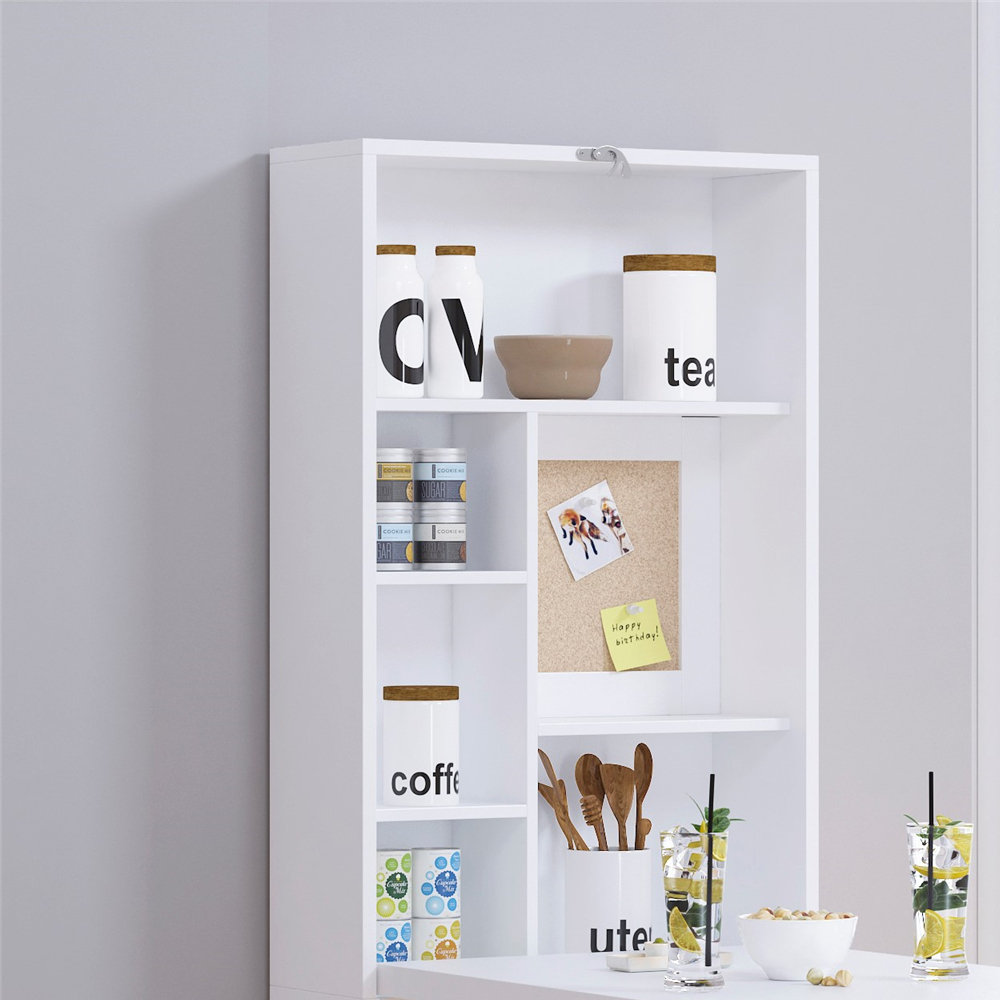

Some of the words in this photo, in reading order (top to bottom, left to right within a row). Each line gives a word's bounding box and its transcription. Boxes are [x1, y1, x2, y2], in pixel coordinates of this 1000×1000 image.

[441, 298, 484, 382] V
[664, 347, 715, 387] tea
[421, 481, 446, 498] SUGAR
[612, 622, 641, 632] Happy
